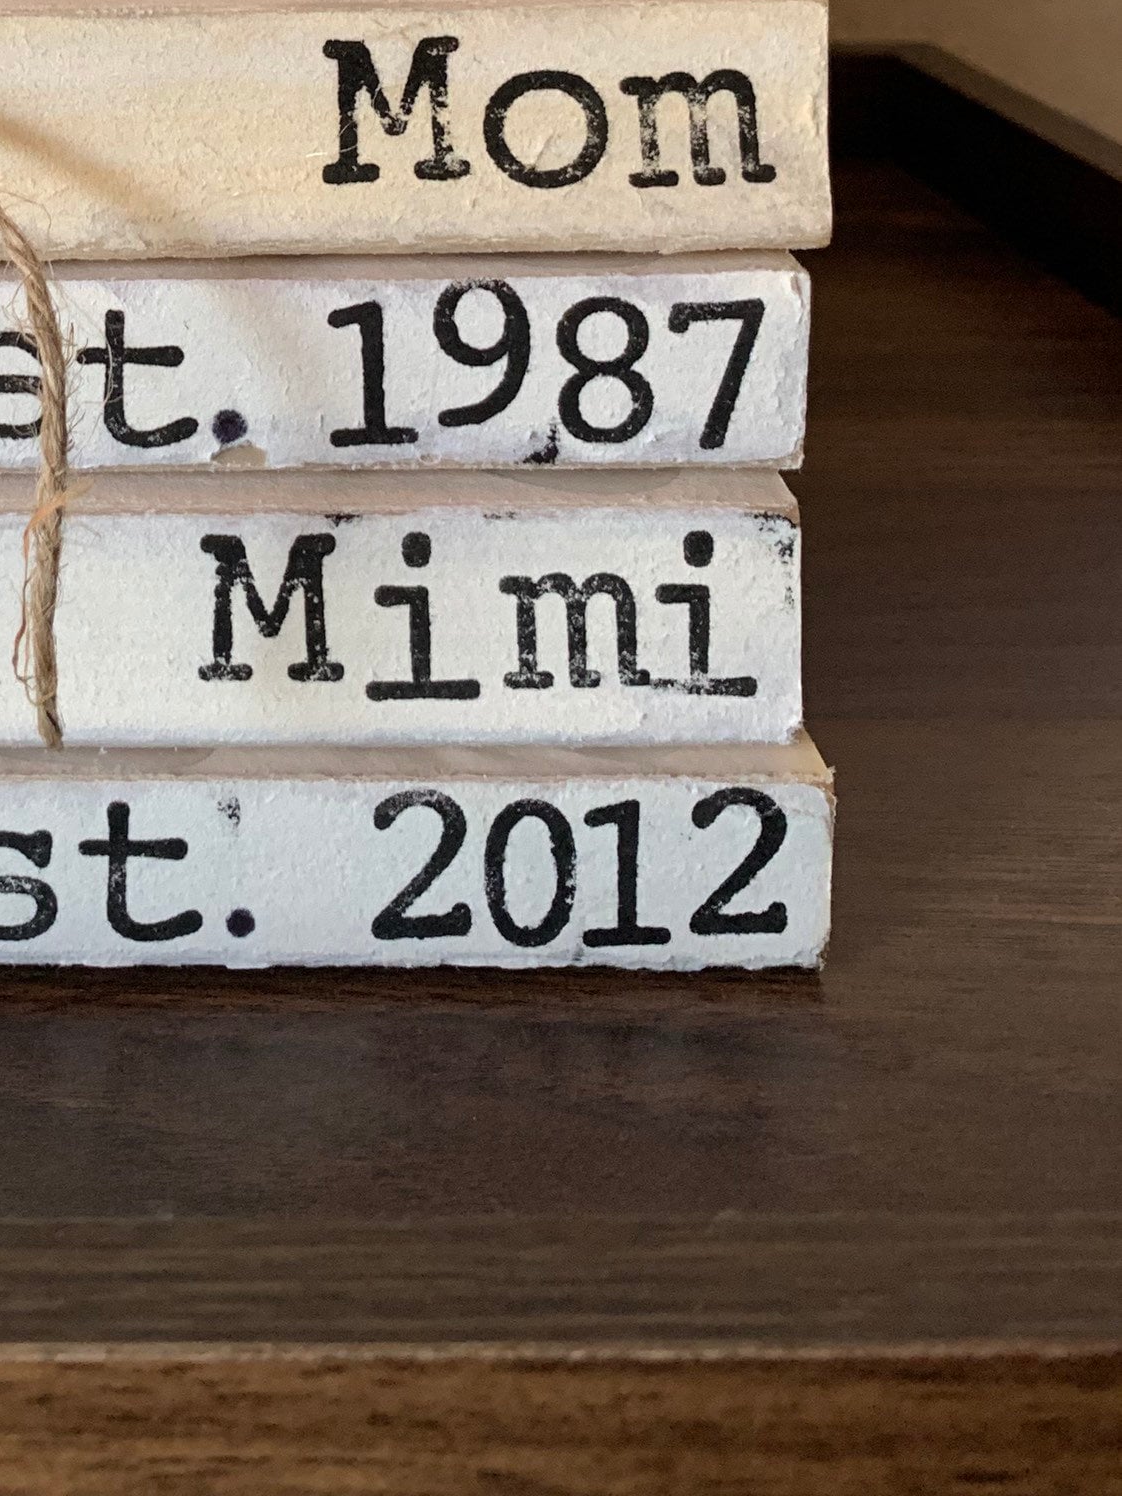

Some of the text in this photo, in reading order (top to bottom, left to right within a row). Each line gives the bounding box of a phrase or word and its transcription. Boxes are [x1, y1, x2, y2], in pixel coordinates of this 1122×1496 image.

[322, 35, 777, 189] Mom
[327, 279, 766, 450] 1987
[198, 530, 758, 702] Mimi
[371, 786, 788, 949] 2012
